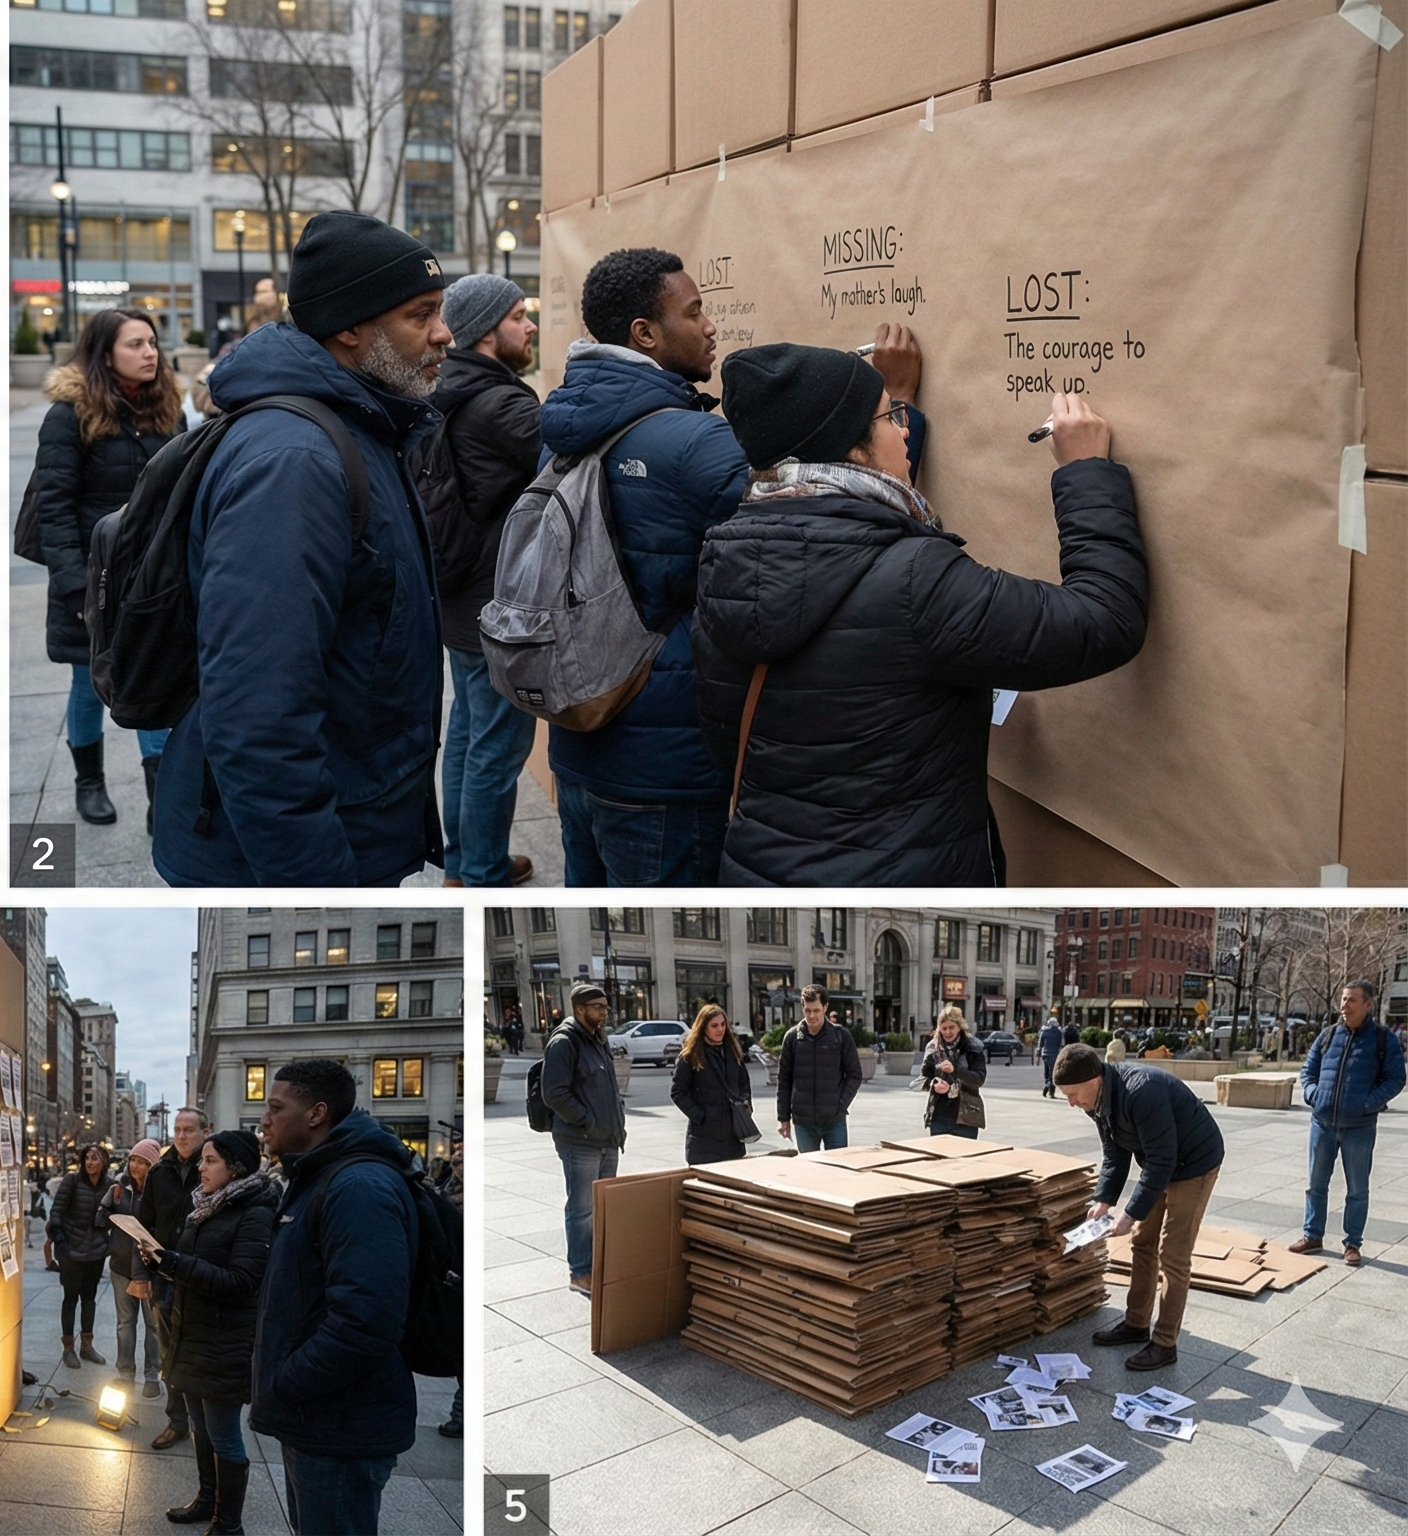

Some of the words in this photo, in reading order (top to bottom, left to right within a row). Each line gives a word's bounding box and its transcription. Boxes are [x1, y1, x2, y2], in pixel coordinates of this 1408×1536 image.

[823, 225, 904, 267] MISSING:
[821, 282, 838, 320] My
[841, 280, 886, 306] mother's
[891, 275, 926, 316] laugh.
[1007, 270, 1090, 313] LOST:
[1003, 331, 1035, 360] The
[1042, 341, 1114, 374] courage
[1122, 329, 1146, 360] to
[1006, 367, 1056, 402] speak
